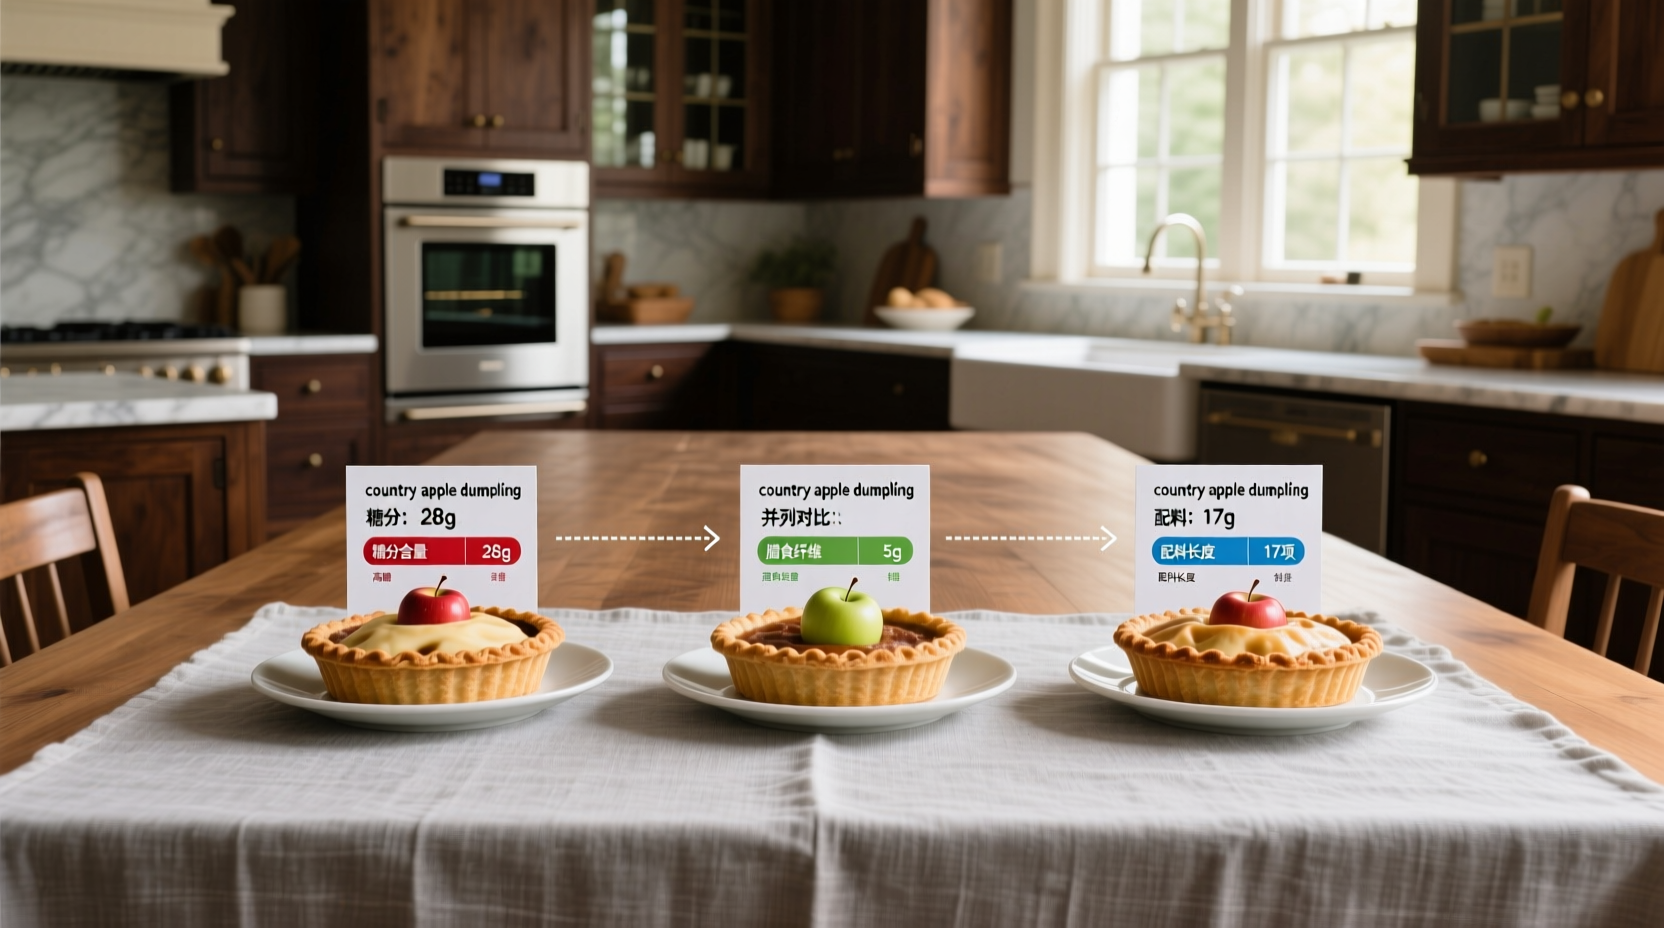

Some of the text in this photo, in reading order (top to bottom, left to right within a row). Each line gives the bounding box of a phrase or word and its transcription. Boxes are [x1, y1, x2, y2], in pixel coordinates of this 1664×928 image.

[365, 482, 521, 501] country apple dumpling
[759, 482, 914, 500] country apple dumpling
[1154, 482, 1309, 501] country apple dumpling
[421, 507, 456, 530] 28g
[1204, 508, 1236, 530] 17g
[482, 544, 511, 562] 28g
[883, 544, 902, 562] 5g
